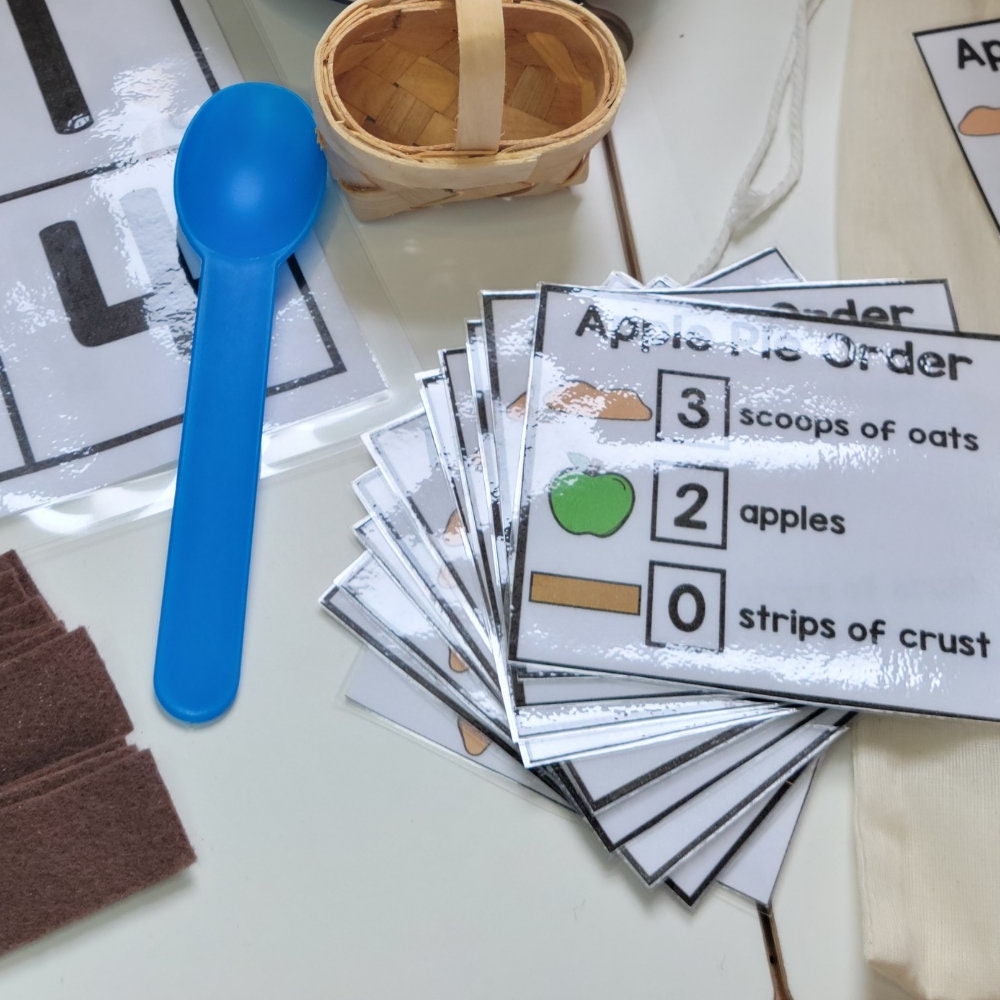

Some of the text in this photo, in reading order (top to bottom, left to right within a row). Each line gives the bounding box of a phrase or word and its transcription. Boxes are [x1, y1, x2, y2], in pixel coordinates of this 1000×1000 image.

[575, 304, 712, 354] Apple
[822, 332, 973, 381] Order
[678, 387, 980, 452] 3 scoops of oats
[673, 482, 847, 535] 2 apples
[668, 582, 991, 659] 0 strips of crust
